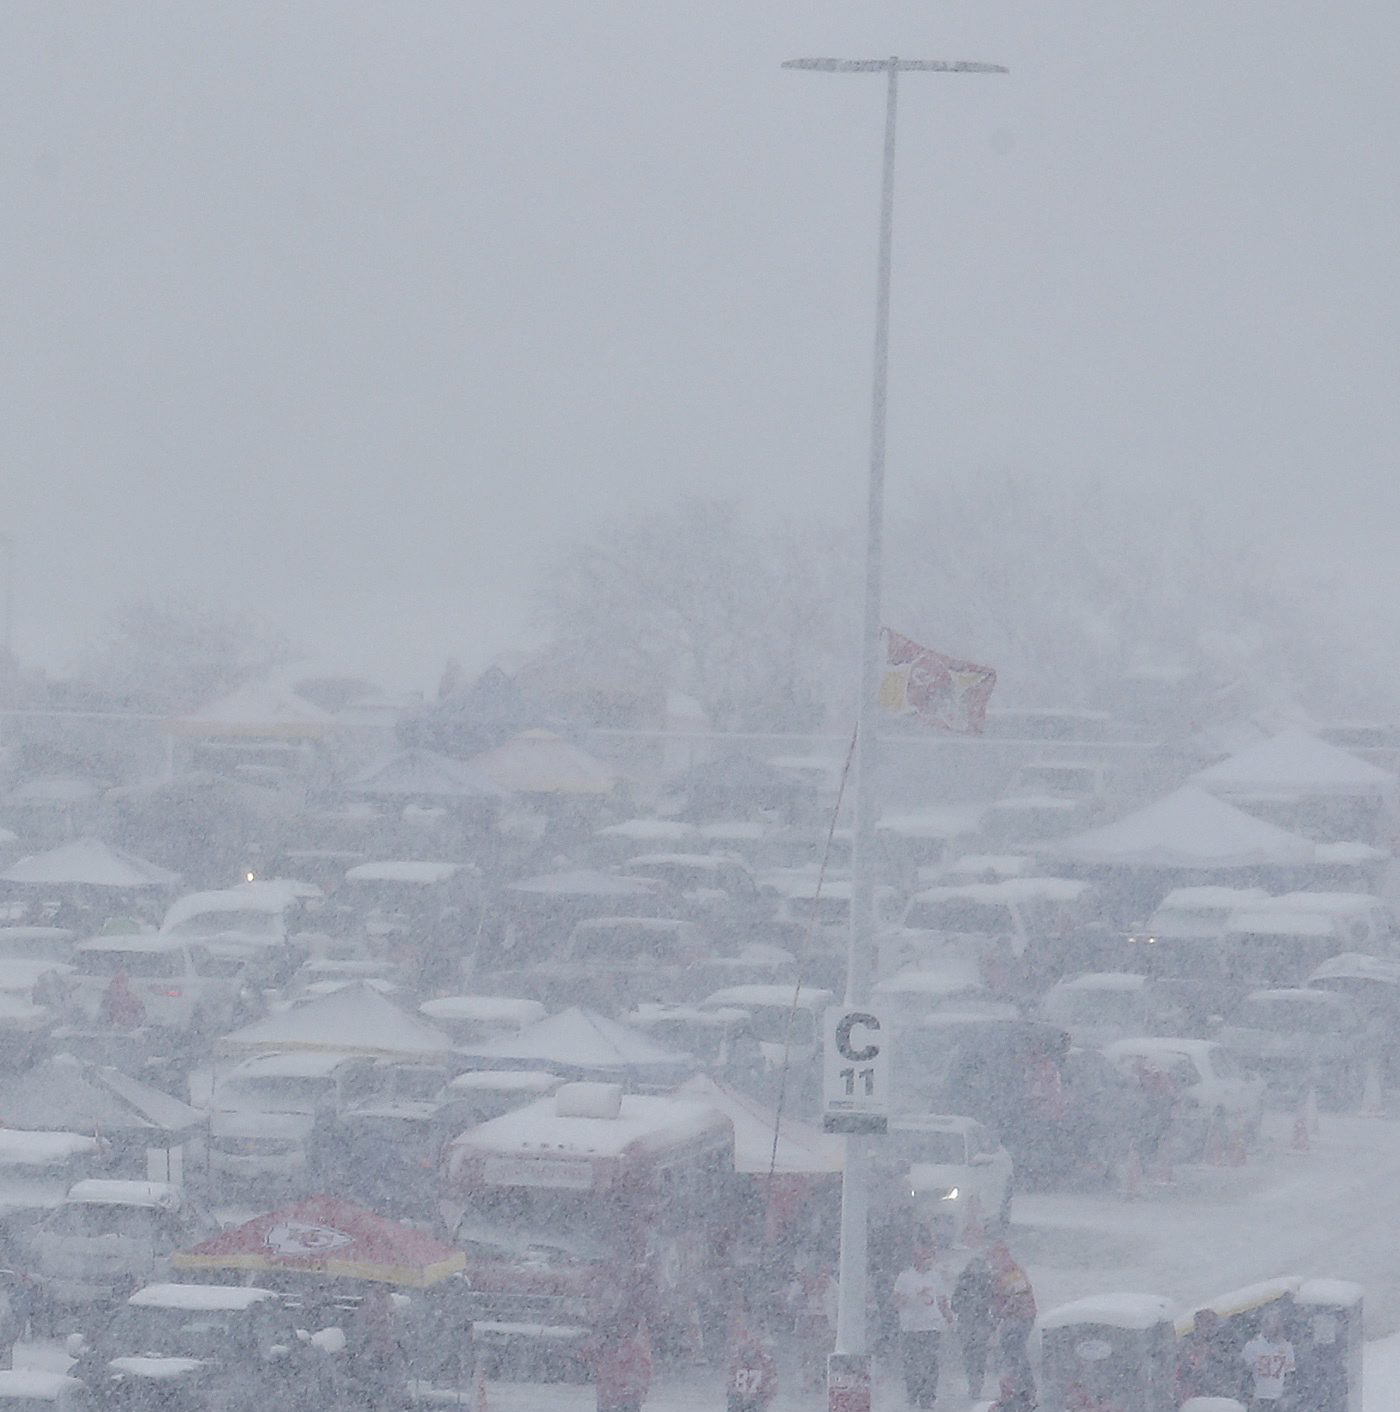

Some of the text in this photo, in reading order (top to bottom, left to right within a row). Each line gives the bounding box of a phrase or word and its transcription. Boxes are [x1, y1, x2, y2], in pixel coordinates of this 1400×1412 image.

[835, 1012, 881, 1062] C
[839, 1067, 875, 1097] 11
[735, 1370, 763, 1393] 87
